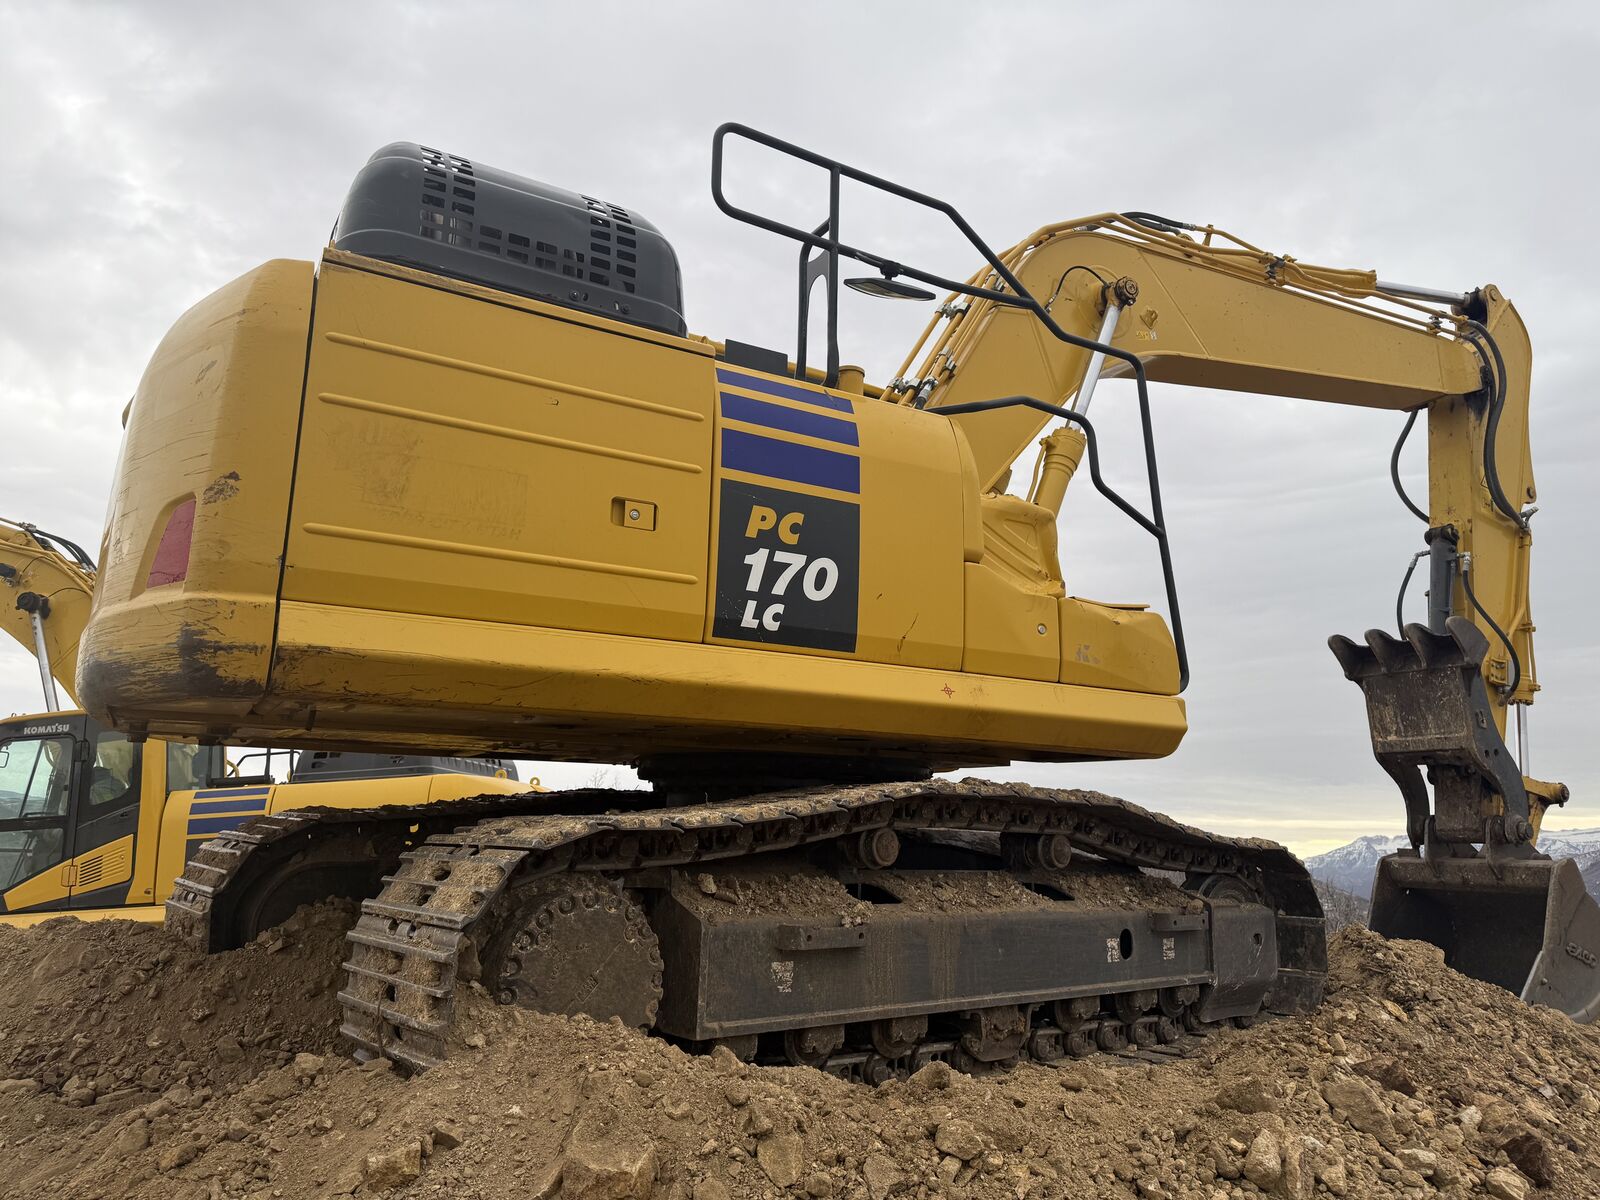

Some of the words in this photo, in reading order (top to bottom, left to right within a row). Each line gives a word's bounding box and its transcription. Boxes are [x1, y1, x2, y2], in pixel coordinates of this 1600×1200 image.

[745, 505, 804, 545] PC
[744, 548, 839, 601] 170
[741, 600, 785, 632] LC
[24, 723, 70, 735] KOMATSU
